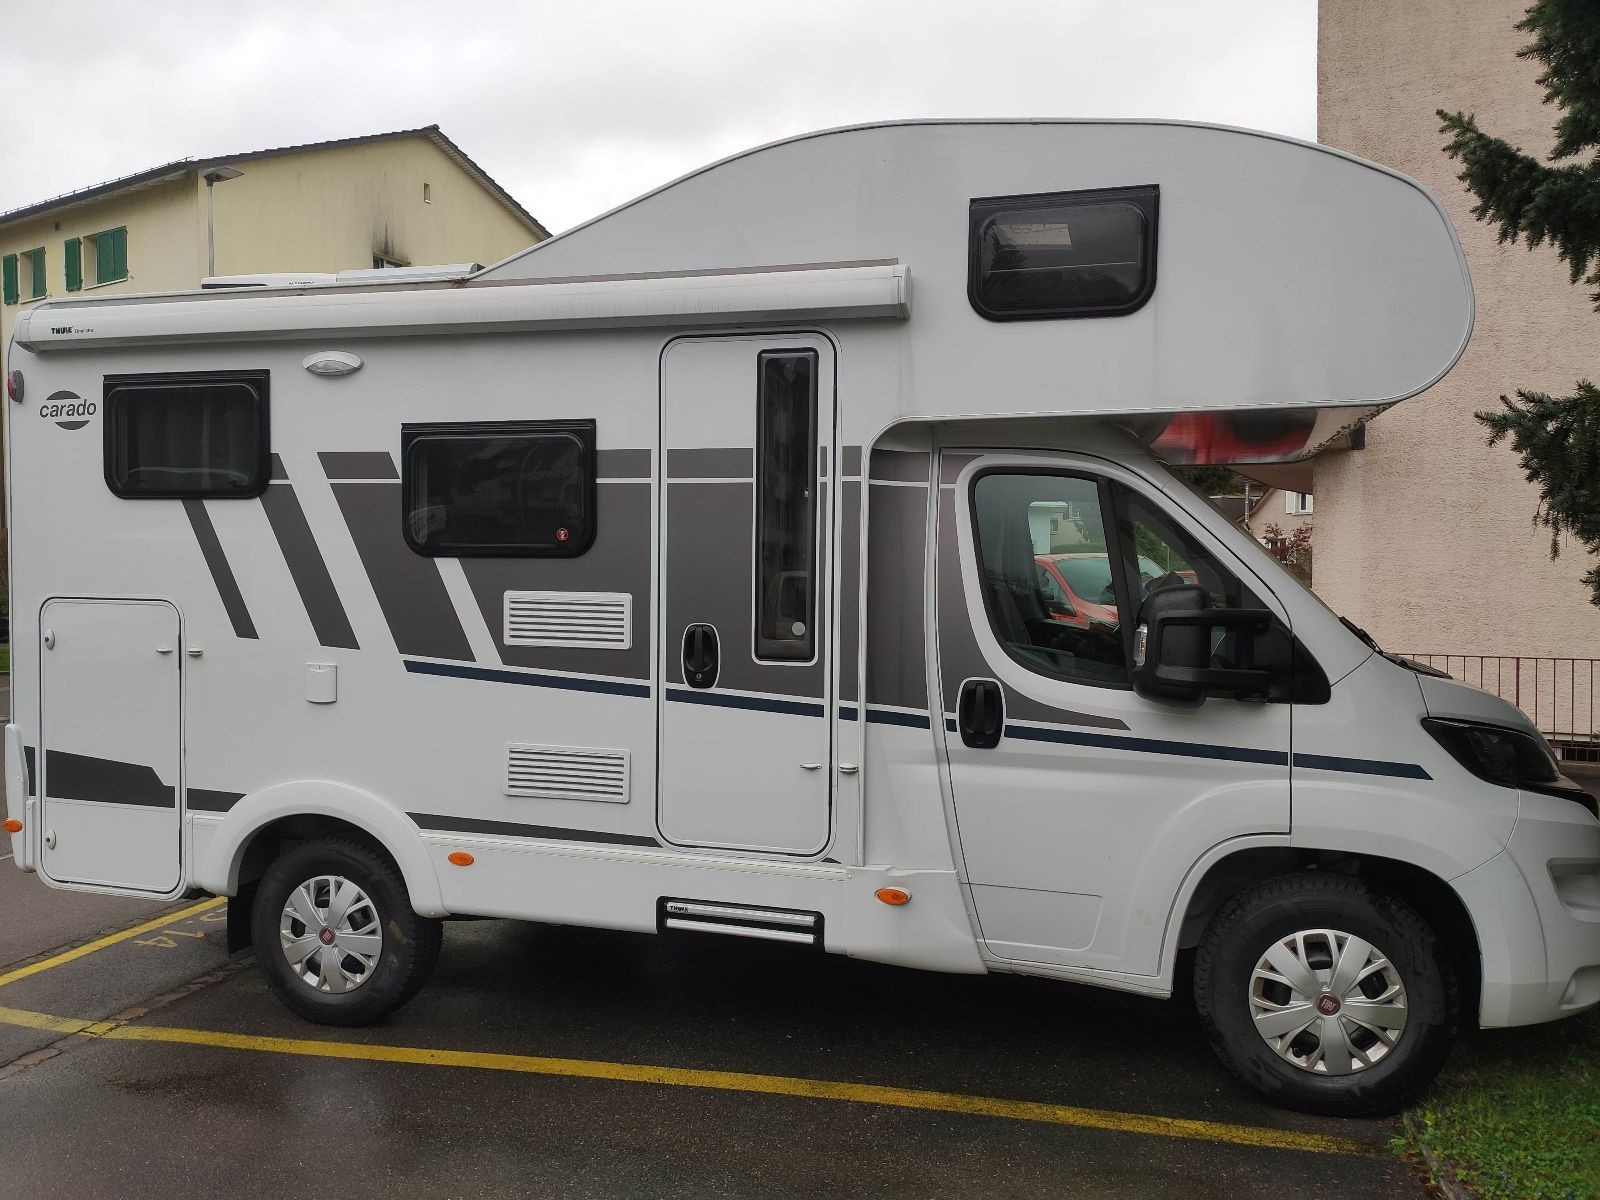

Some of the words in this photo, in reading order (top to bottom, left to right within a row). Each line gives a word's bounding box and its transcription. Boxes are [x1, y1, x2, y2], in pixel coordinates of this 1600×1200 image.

[51, 326, 73, 335] THULE
[40, 398, 97, 418] carado
[1321, 998, 1337, 1012] FIAT
